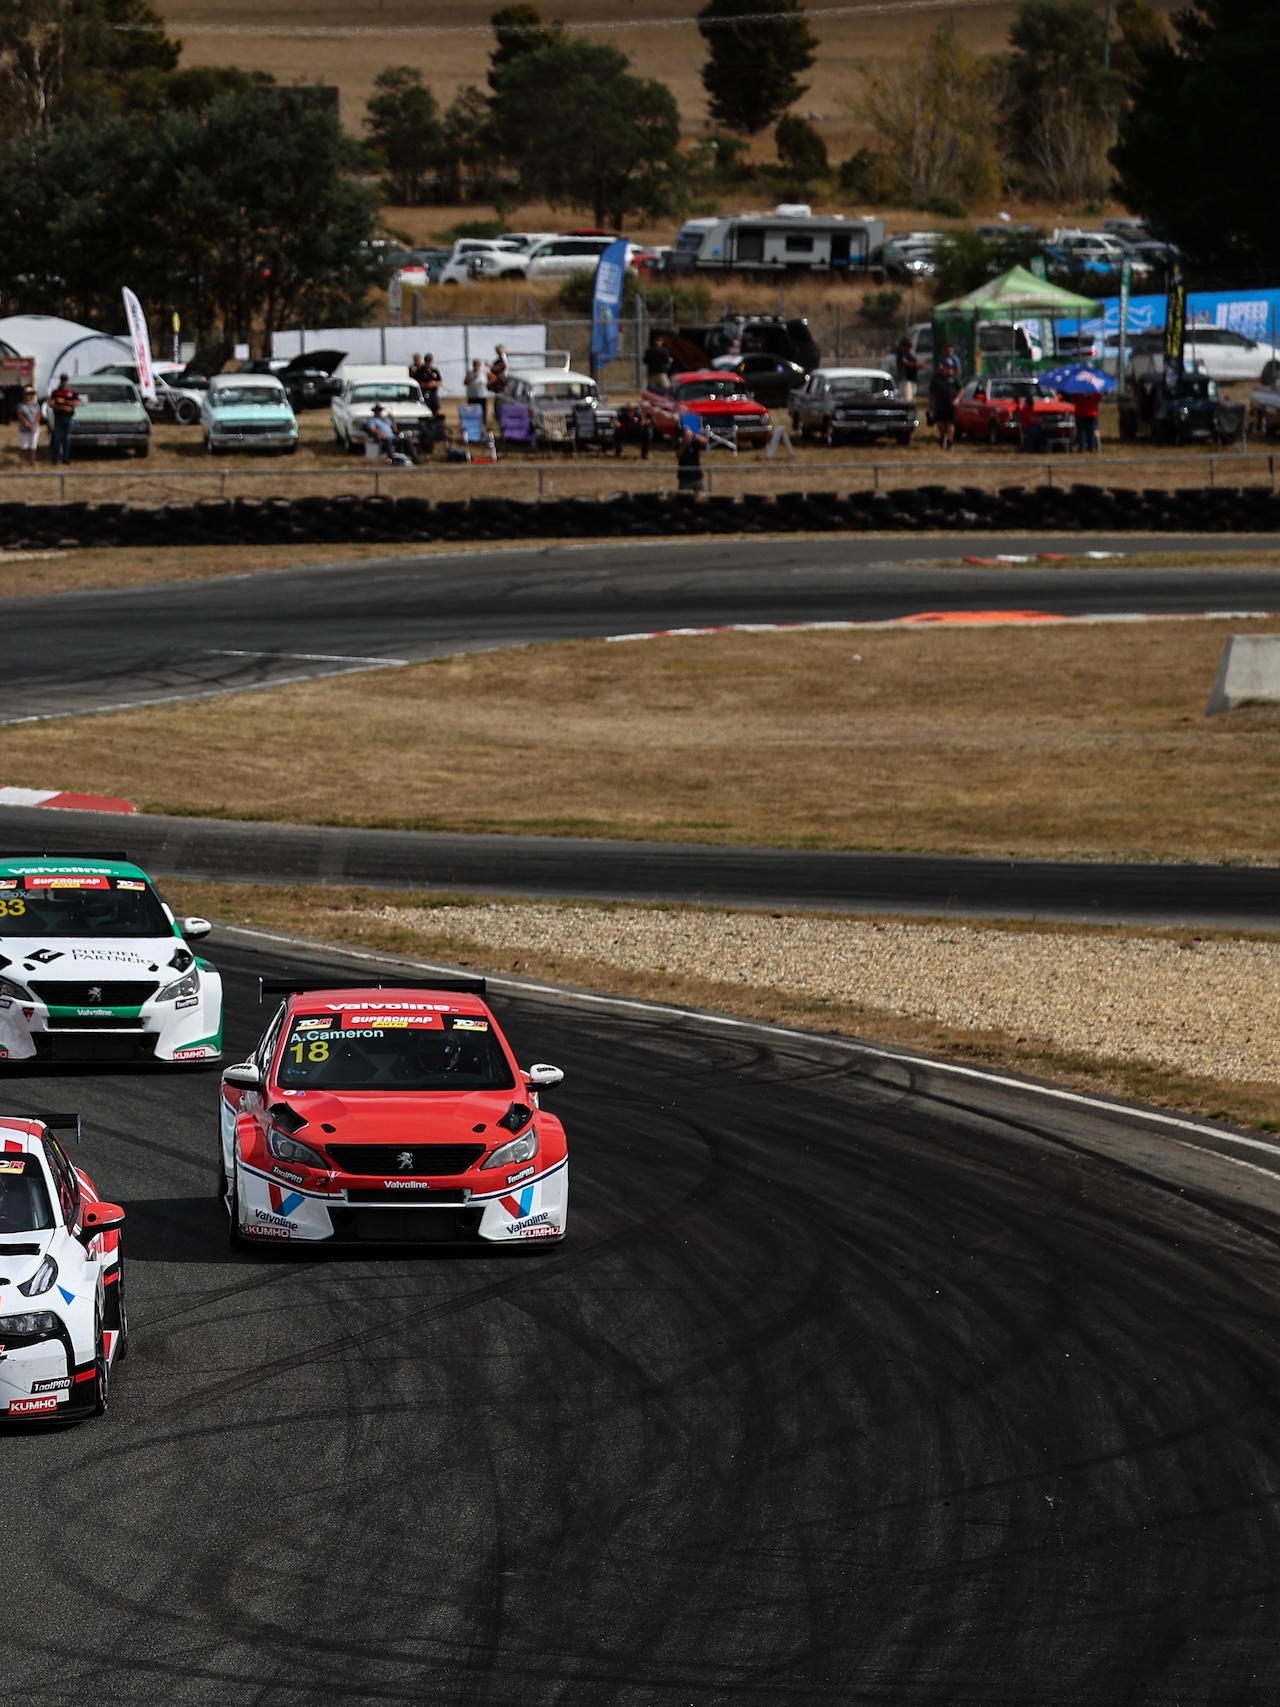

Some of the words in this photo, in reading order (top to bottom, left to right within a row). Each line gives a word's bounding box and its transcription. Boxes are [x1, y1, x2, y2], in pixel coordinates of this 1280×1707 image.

[72, 949, 141, 958] PITCHER
[73, 954, 155, 965] PARTNERS
[351, 1016, 433, 1024] SUPERCHEAP
[290, 1030, 384, 1043] A.Cameron
[174, 1050, 206, 1059] KUMHO
[289, 1041, 330, 1064] 18
[272, 1165, 304, 1184] ToolPRO
[506, 1165, 535, 1184] ToolPRO
[254, 1208, 299, 1231] Valvoline
[506, 1212, 549, 1234] Valvoline
[248, 1225, 290, 1238] KUMHO
[520, 1226, 559, 1238] KUMHO
[34, 1379, 71, 1392] ToolPRO
[10, 1399, 57, 1412] KUMHO
